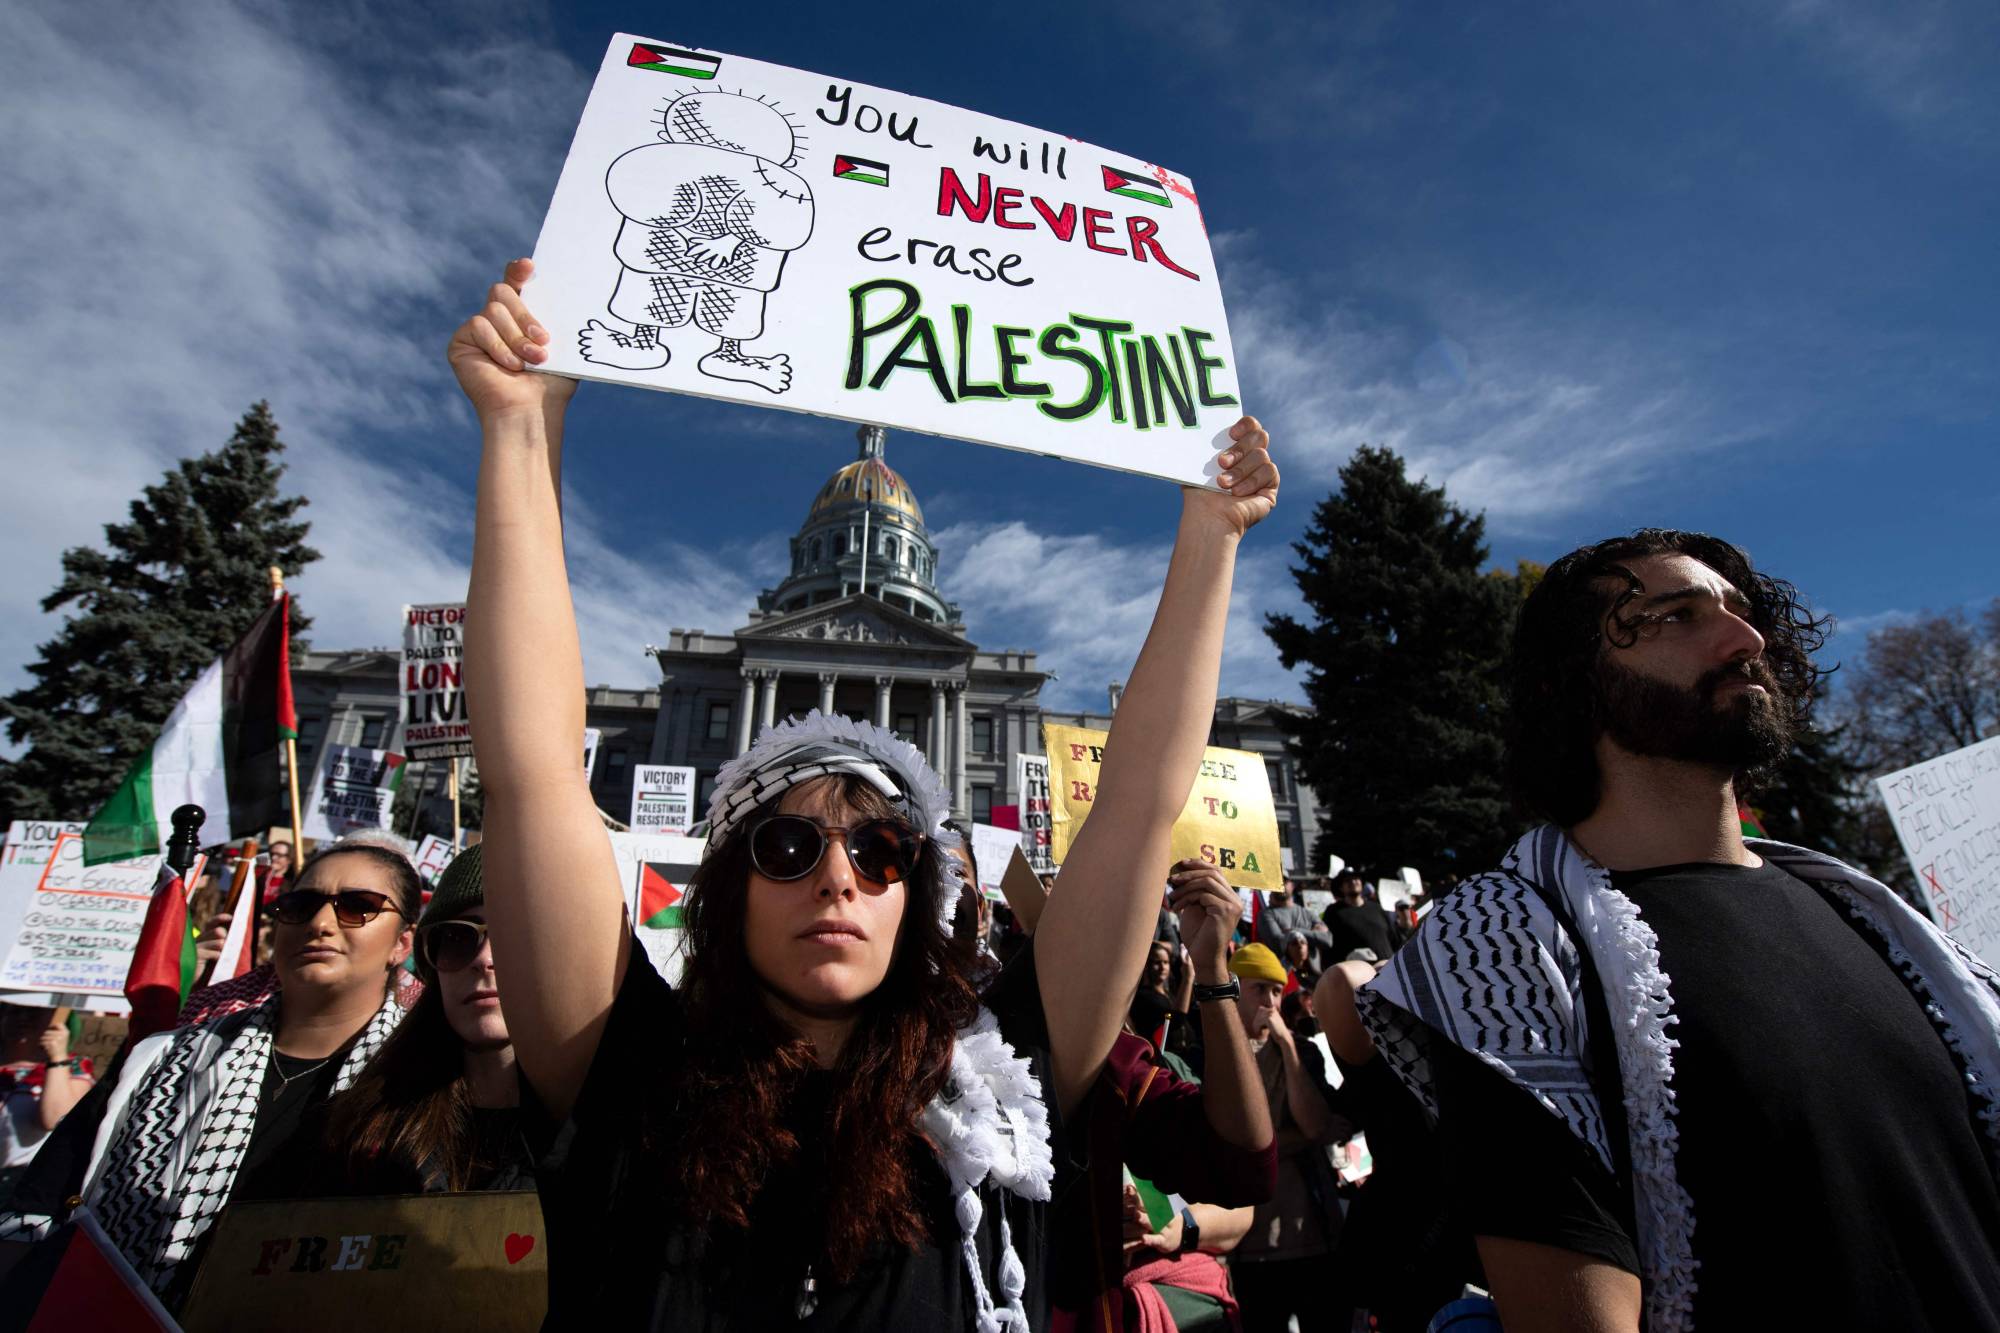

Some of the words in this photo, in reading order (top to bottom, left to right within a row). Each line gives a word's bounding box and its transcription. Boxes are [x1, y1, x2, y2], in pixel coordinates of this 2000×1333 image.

[816, 84, 933, 149] you
[973, 136, 1067, 180] will
[936, 166, 1201, 282] NEVER
[857, 227, 1035, 287] erase
[844, 278, 1239, 432] PALESTINE
[408, 607, 466, 626] VICTOR
[433, 627, 455, 642] TO
[407, 662, 463, 691] LON
[406, 724, 470, 741] PALESTIN
[1069, 743, 1104, 763] FR
[1200, 759, 1237, 780] HE
[643, 770, 687, 785] VICTORY
[1029, 780, 1049, 796] TH
[322, 789, 384, 809] PALESTINE
[636, 803, 686, 814] PALESTINIAN
[1027, 799, 1051, 812] RIV
[1203, 797, 1238, 819] TO
[636, 814, 686, 826] RESISTANCE
[1026, 814, 1043, 829] TO
[23, 822, 60, 841] YOU
[1035, 829, 1052, 846] SE
[1026, 847, 1052, 858] PALE
[1200, 844, 1262, 873] SEA
[104, 919, 142, 933] OCCU
[251, 1234, 408, 1277] FREE
